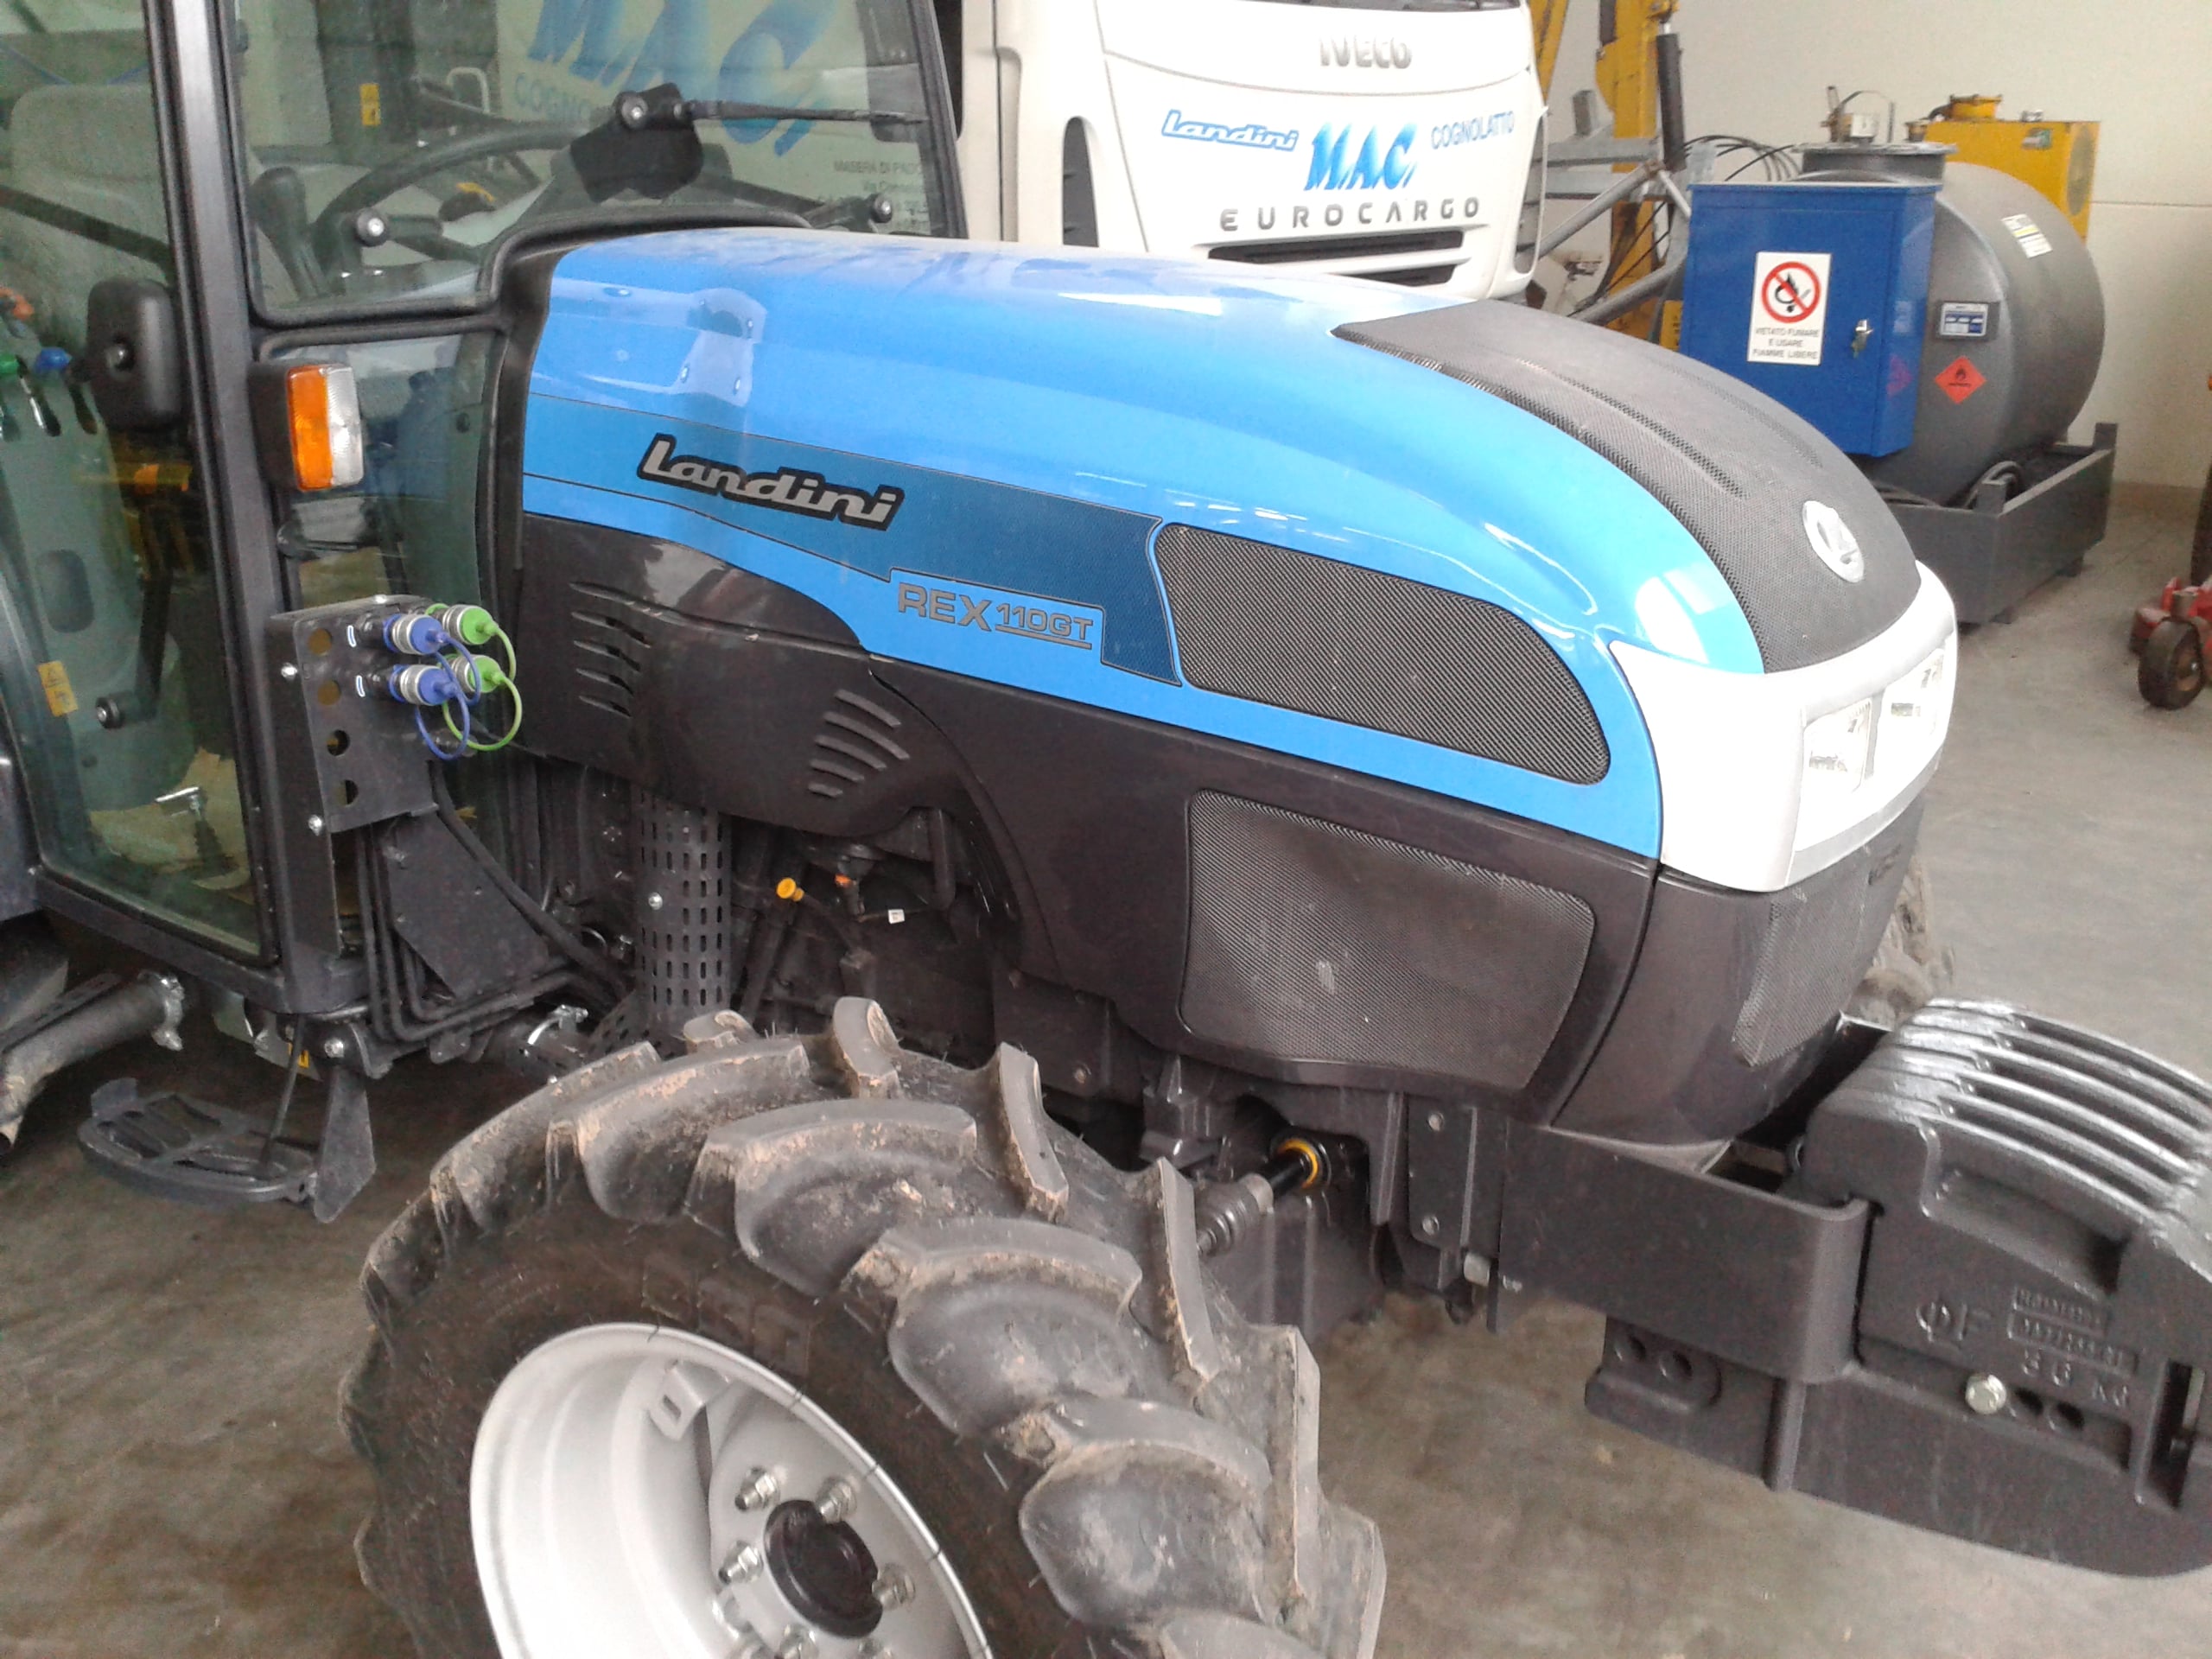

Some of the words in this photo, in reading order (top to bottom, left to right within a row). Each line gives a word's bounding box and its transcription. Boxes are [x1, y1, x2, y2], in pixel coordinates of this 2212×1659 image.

[1319, 34, 1413, 69] IVECO
[1161, 109, 1299, 151] Landini
[1304, 121, 1417, 191] MAC
[1430, 111, 1516, 149] COGNOLATTO
[1219, 196, 1480, 232] EUROCARGO
[1769, 338, 1774, 346] E
[1776, 339, 1804, 347] USARE
[1788, 327, 1820, 338] FUMARE
[1752, 348, 1785, 358] FIAMME
[1788, 350, 1819, 359] LIBERE
[639, 435, 902, 529] Landini
[897, 582, 993, 632] REX
[995, 603, 1094, 644] 110GT
